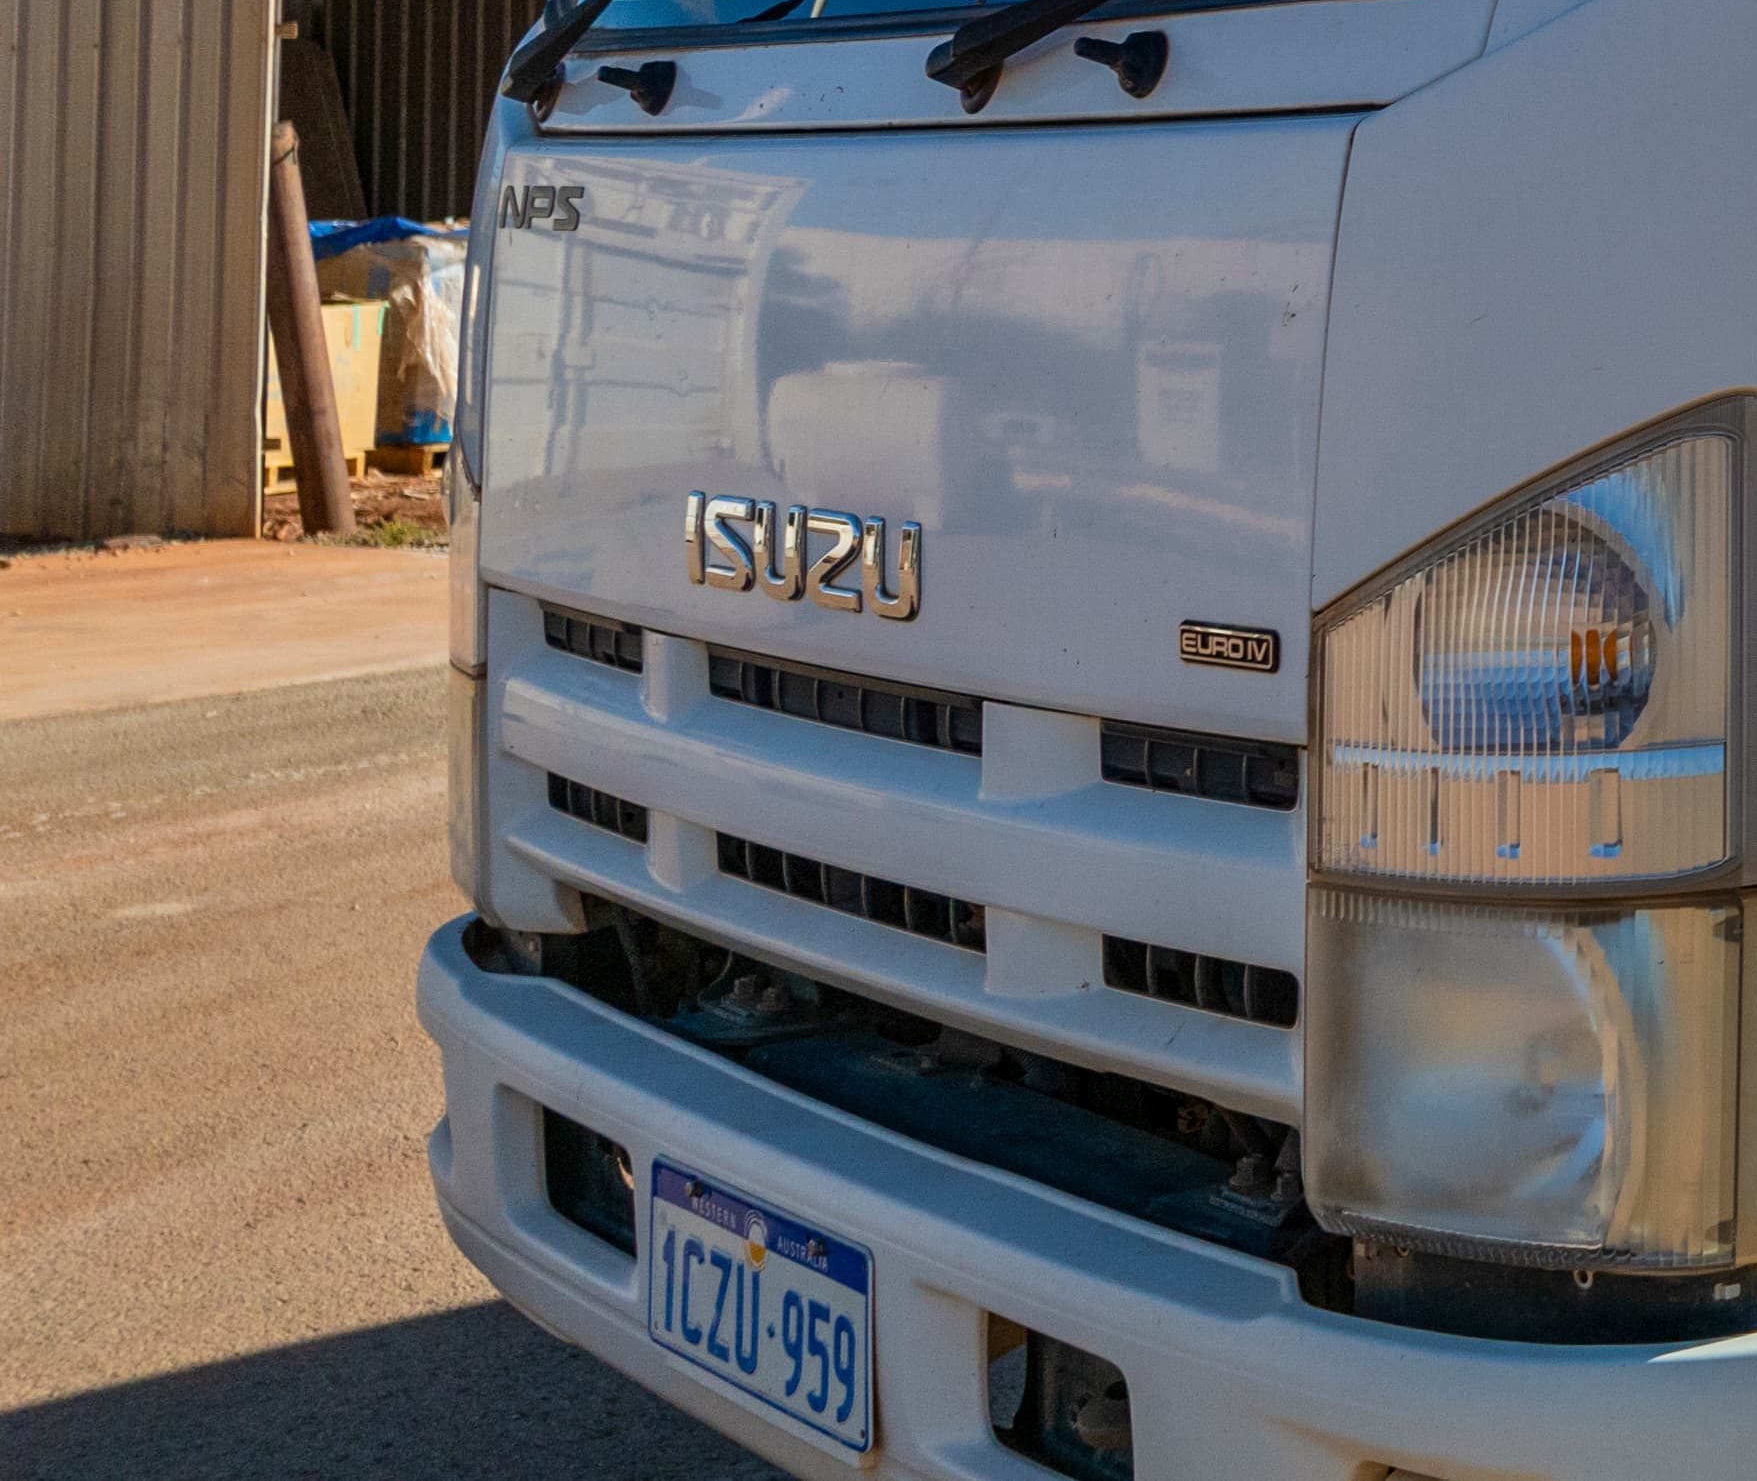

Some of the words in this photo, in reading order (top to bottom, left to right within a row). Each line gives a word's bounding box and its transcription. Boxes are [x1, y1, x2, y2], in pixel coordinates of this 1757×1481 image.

[499, 185, 585, 231] NPS
[685, 490, 922, 622] ISUZU
[1182, 632, 1244, 659] EURO
[1247, 640, 1268, 661] IV
